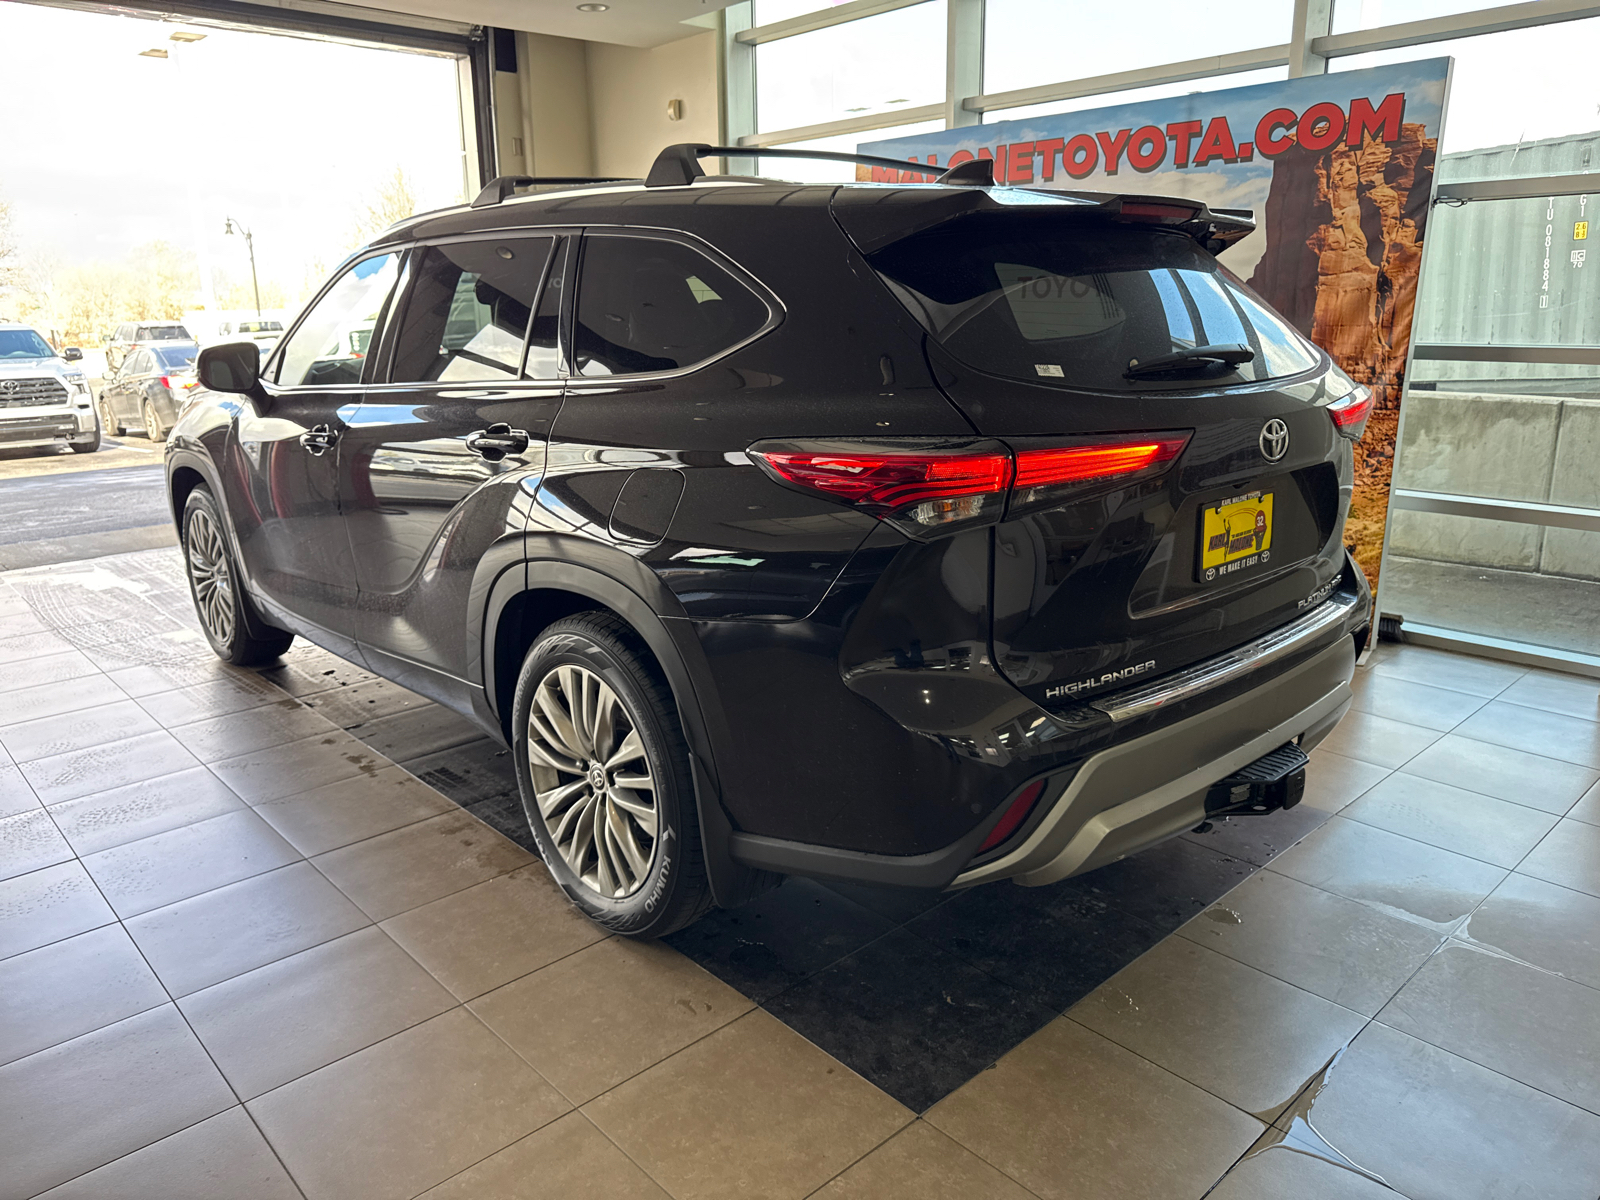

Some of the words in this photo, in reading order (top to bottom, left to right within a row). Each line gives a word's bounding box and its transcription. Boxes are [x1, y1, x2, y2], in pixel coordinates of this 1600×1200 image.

[1017, 275, 1100, 299] TOYO
[1256, 515, 1264, 527] 32
[1219, 565, 1226, 575] WE
[1227, 560, 1240, 573] MAKE
[1247, 555, 1258, 567] EASY
[1045, 658, 1157, 699] HIGHLANDER
[644, 854, 671, 914] KUMHO
